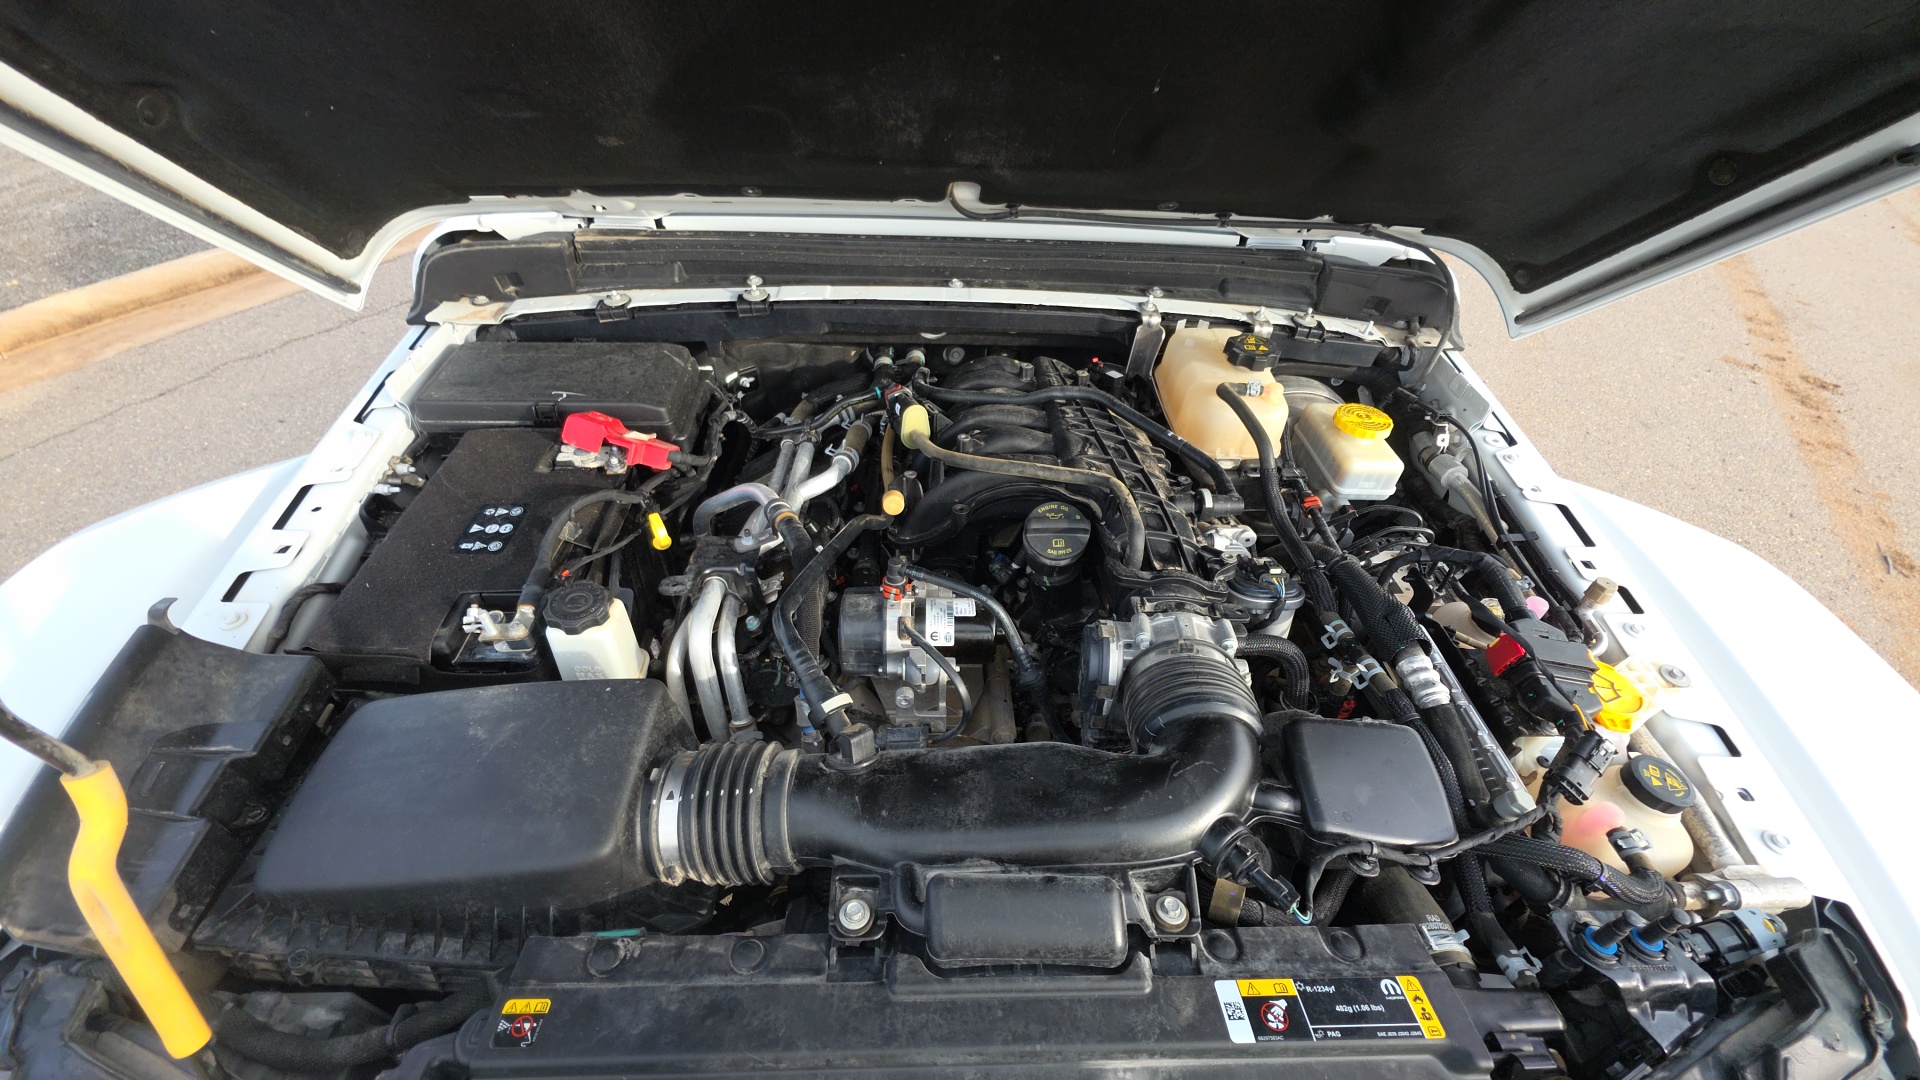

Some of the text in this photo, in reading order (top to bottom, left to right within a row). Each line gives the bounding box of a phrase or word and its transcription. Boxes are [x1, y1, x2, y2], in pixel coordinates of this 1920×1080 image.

[1037, 504, 1058, 513] ENGINE
[574, 665, 601, 673] COLD
[1426, 914, 1441, 922] RAD
[1335, 1004, 1353, 1013] 482g
